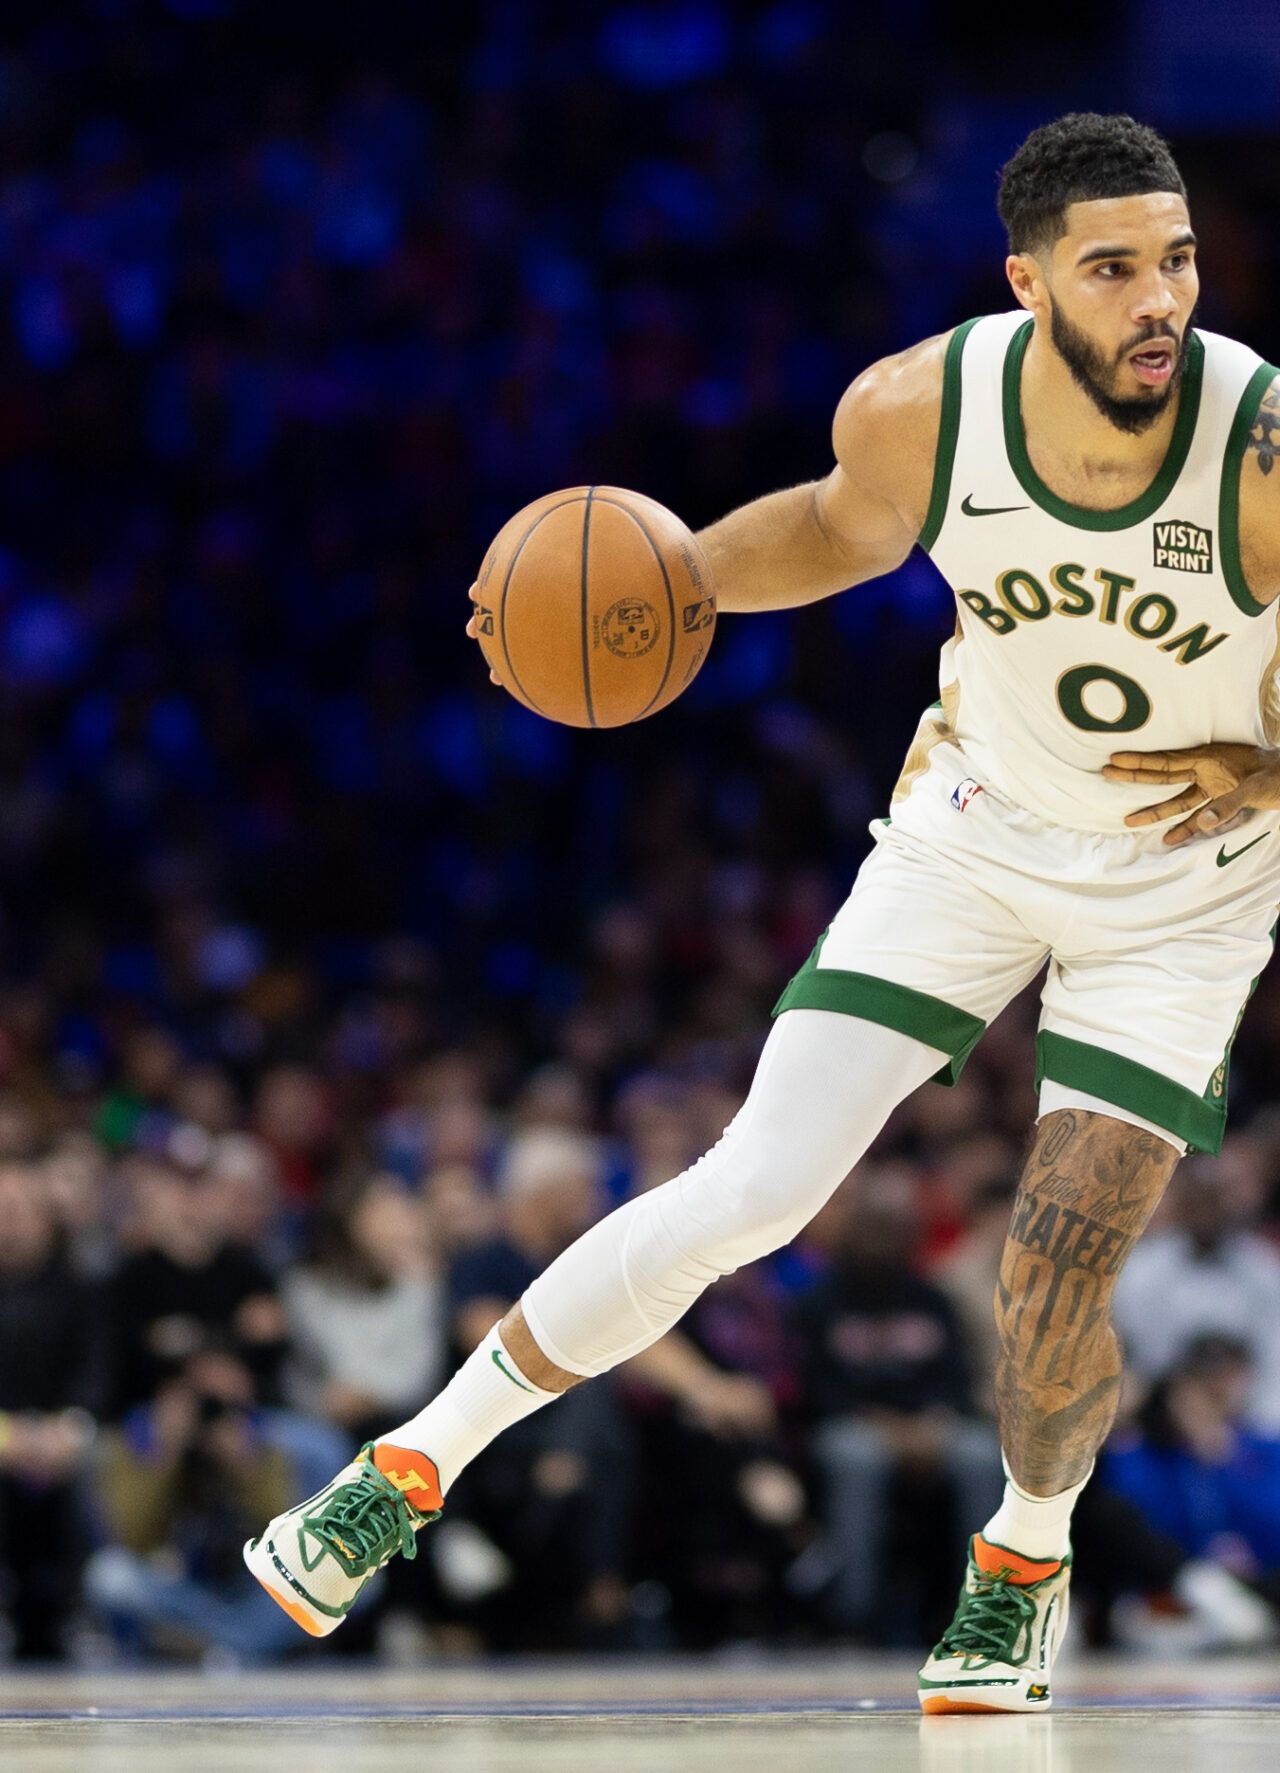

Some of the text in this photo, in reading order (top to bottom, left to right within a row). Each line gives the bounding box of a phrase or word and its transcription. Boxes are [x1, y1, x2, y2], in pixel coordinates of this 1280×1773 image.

[1156, 525, 1209, 554] VISTA
[1156, 548, 1210, 572] PRINT
[955, 562, 1231, 665] BOSTON
[1055, 662, 1153, 733] 0
